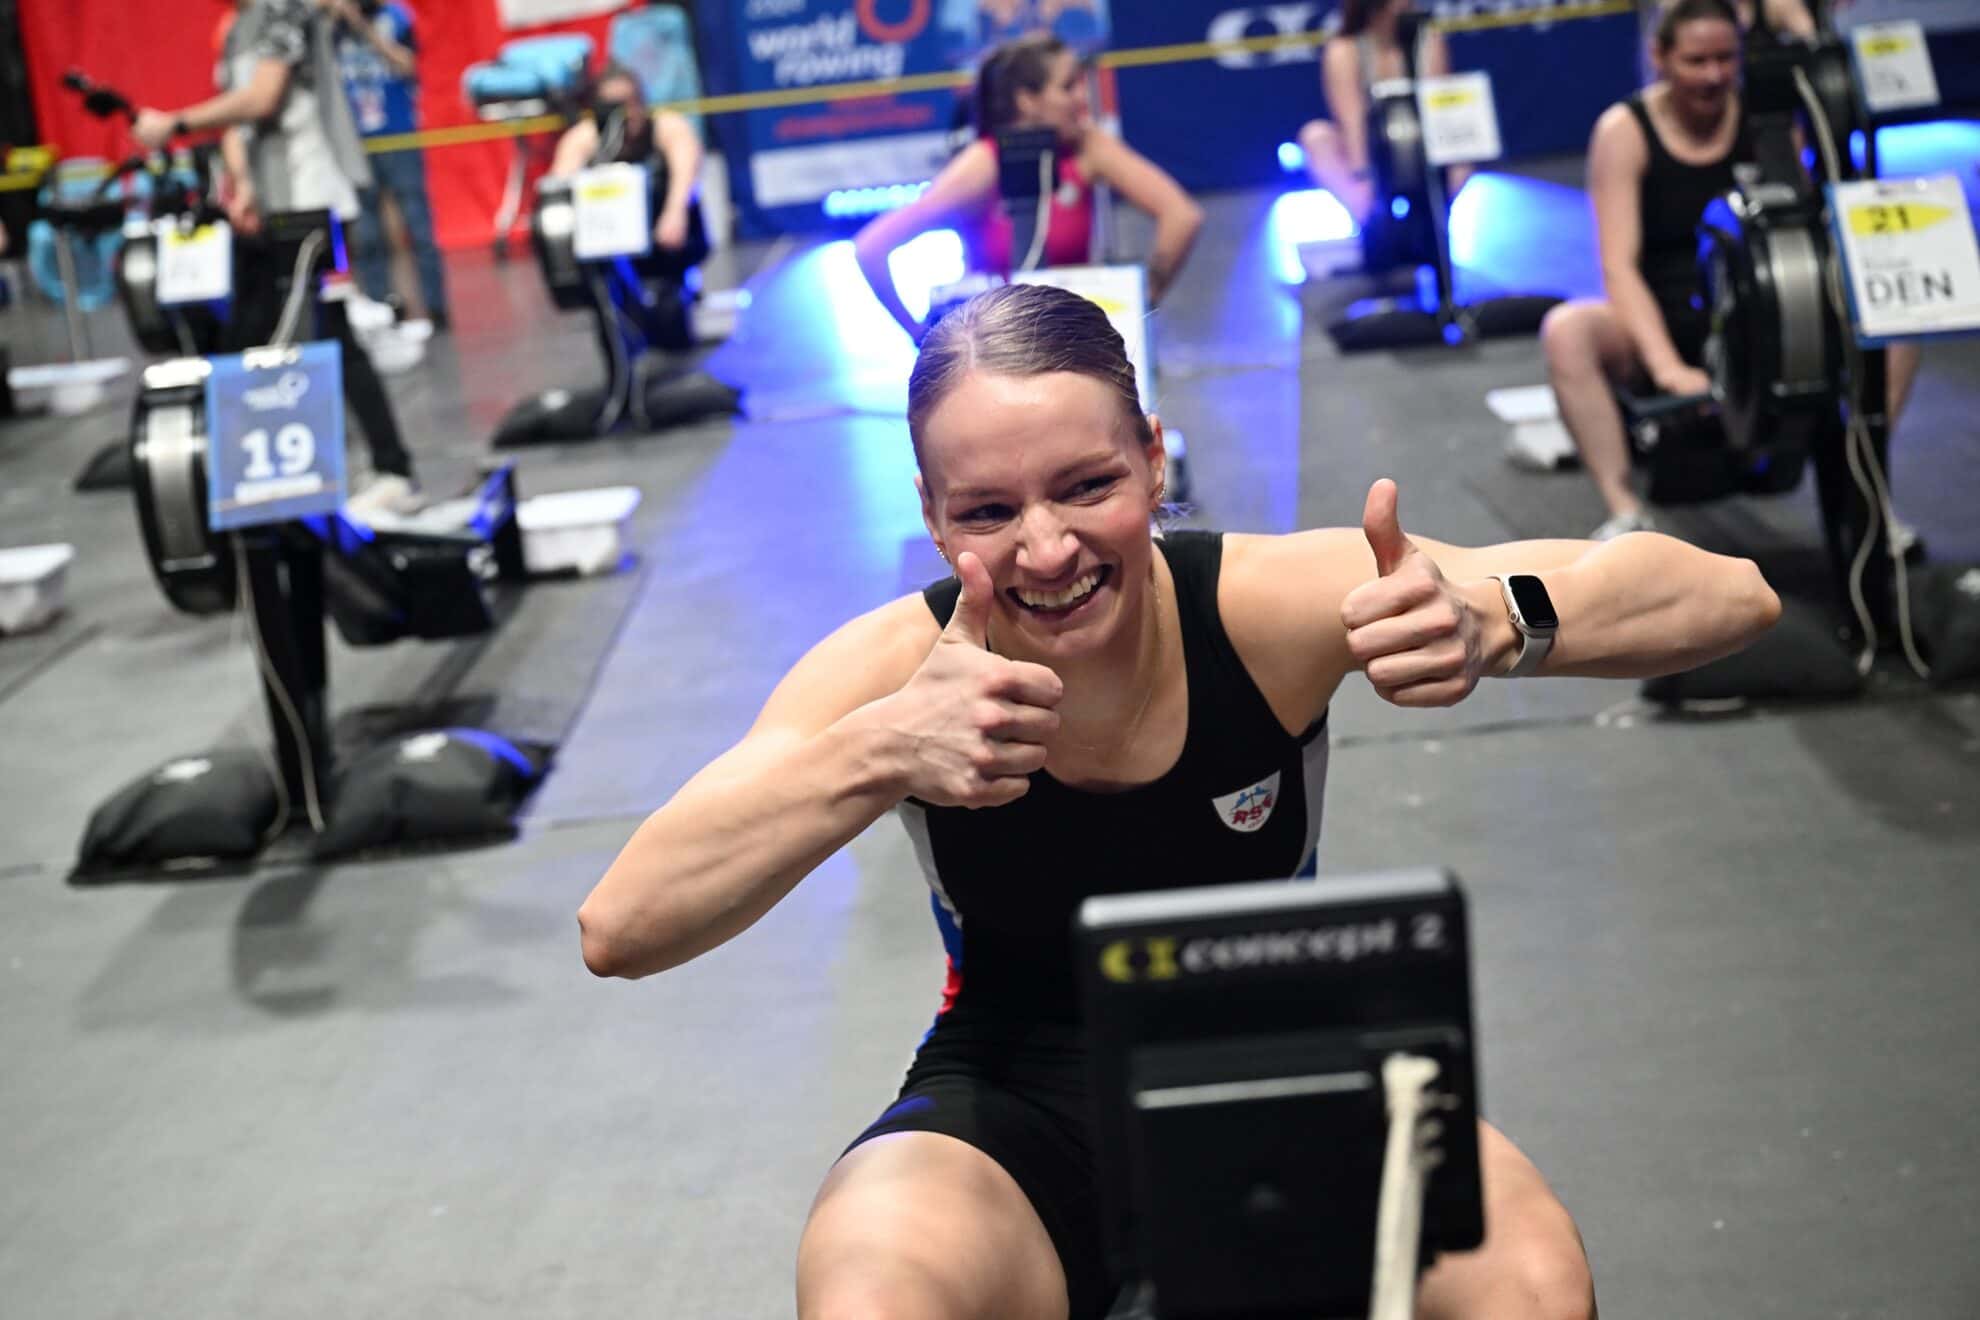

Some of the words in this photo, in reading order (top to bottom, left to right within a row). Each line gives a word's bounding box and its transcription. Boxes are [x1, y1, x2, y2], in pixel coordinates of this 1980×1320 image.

[1864, 206, 1911, 234] 21
[1864, 270, 1954, 307] DEN
[240, 424, 316, 479] 19
